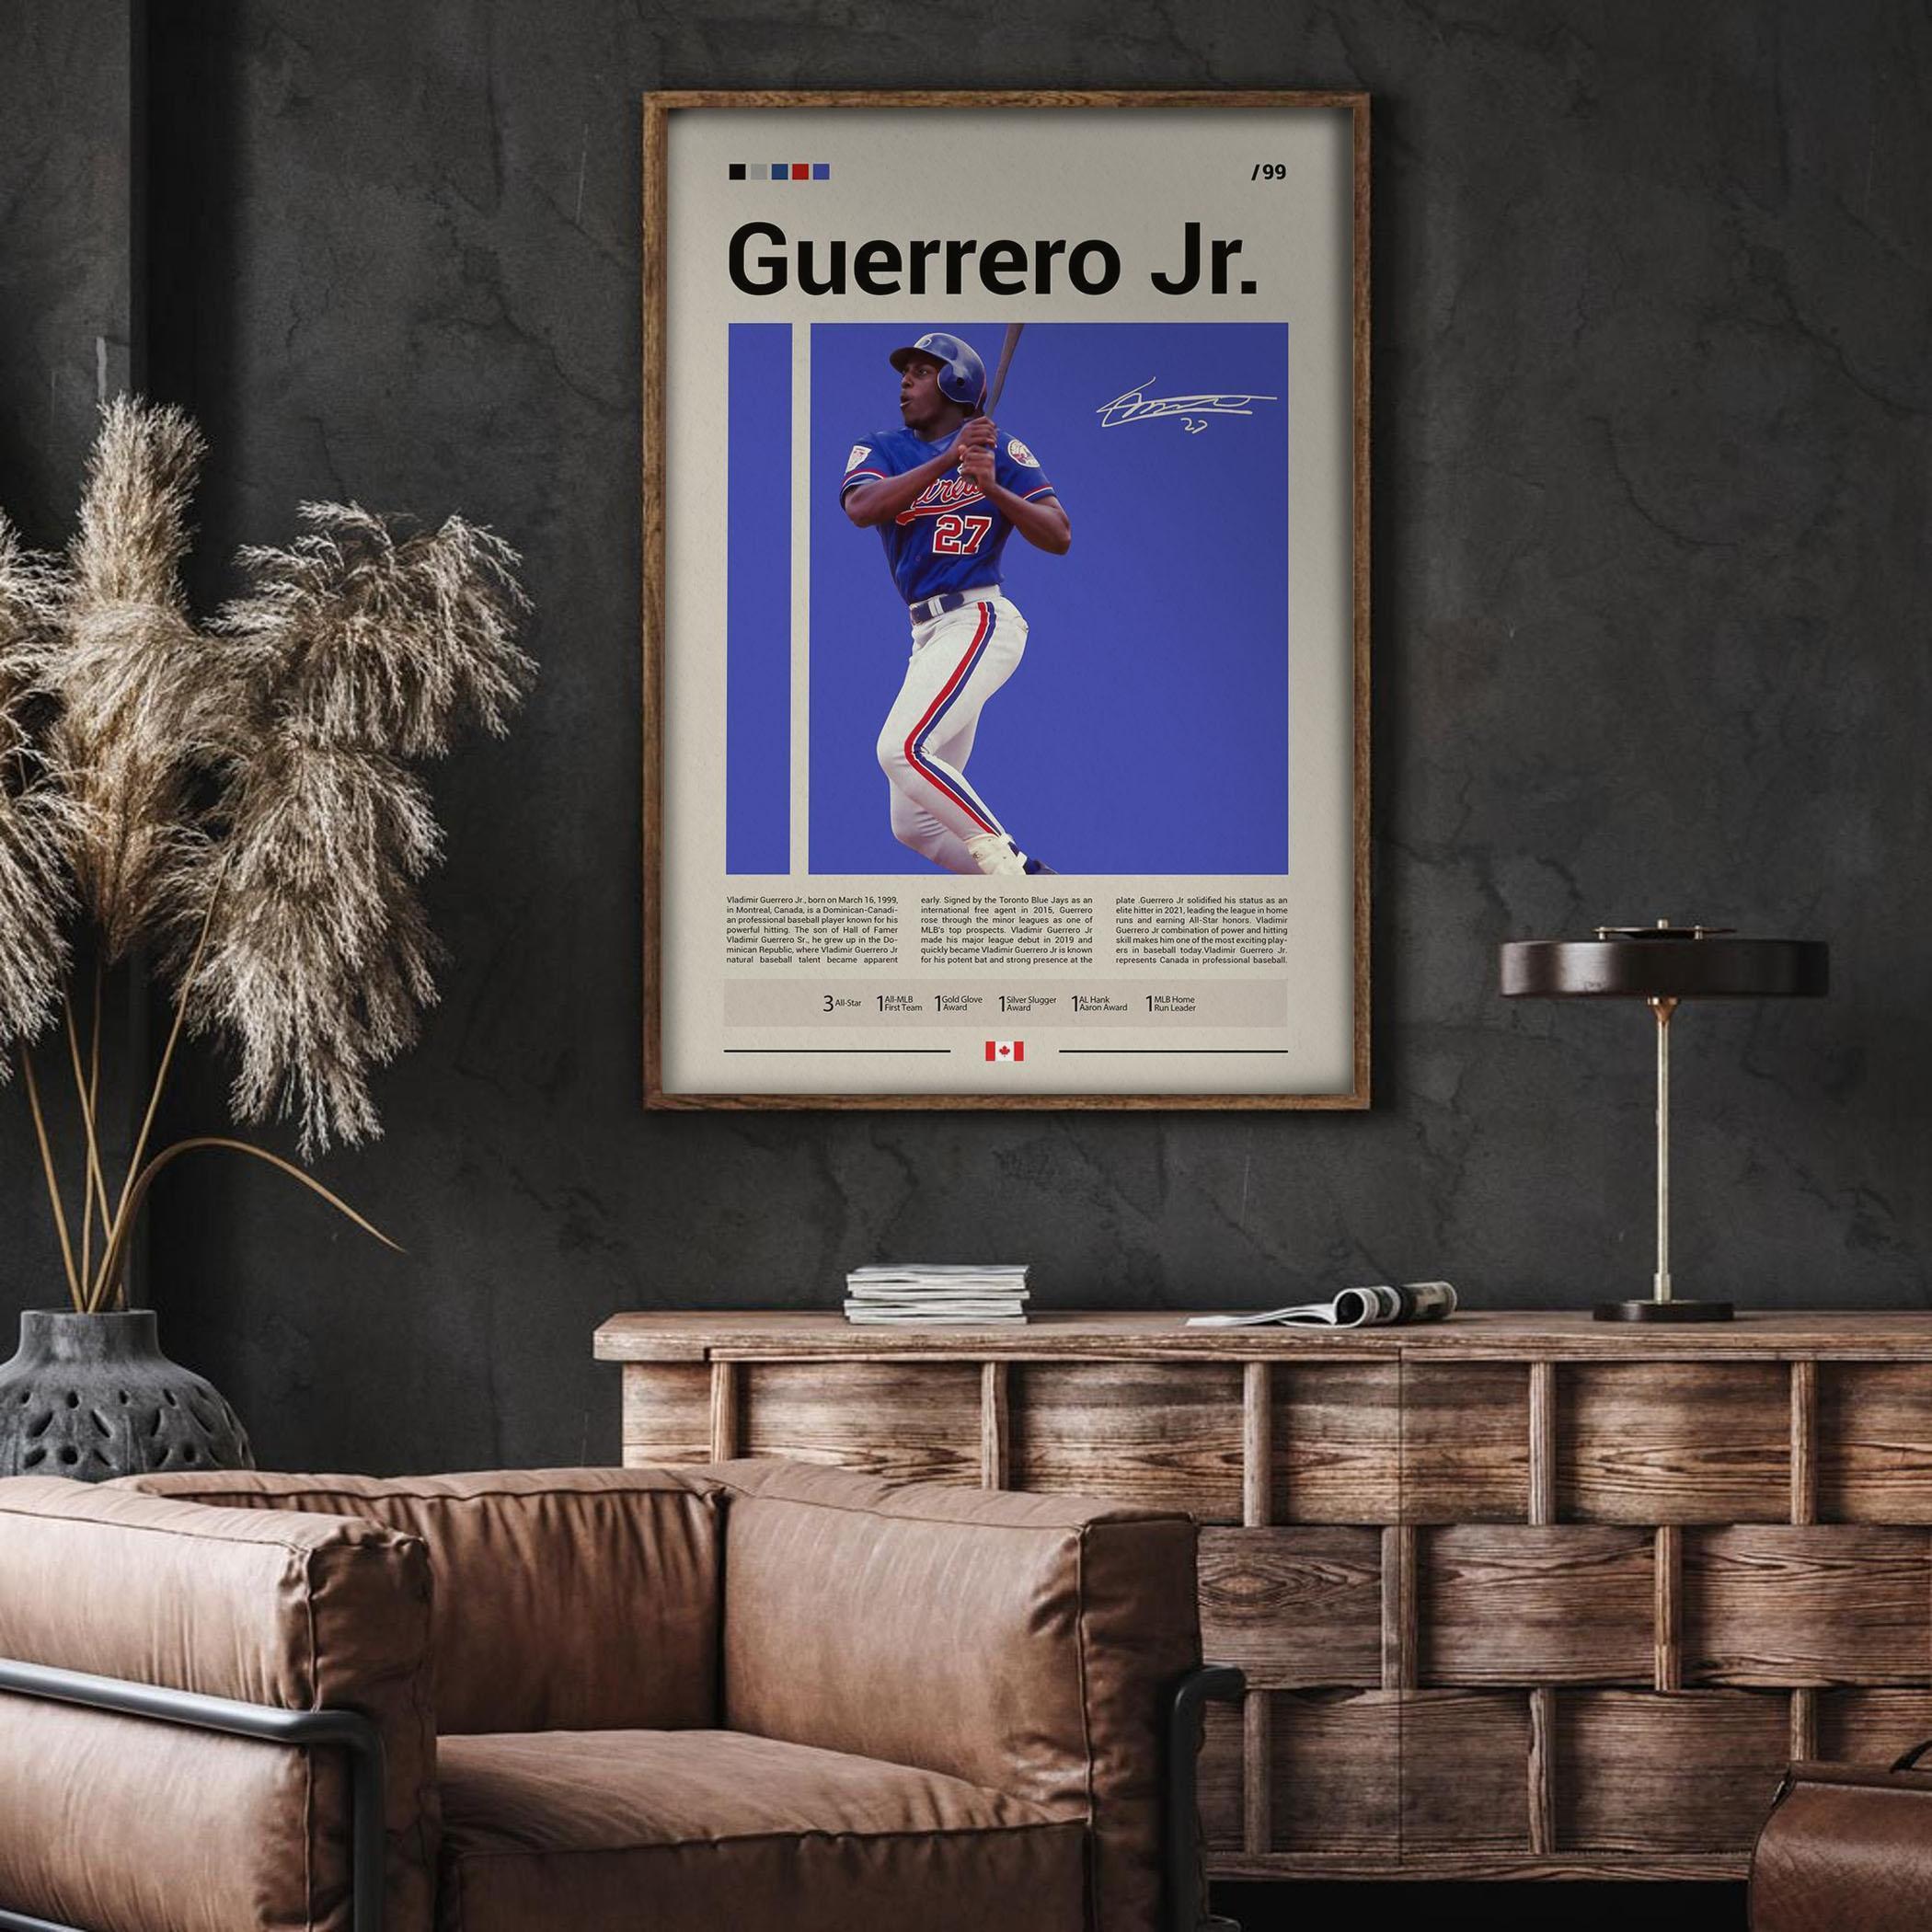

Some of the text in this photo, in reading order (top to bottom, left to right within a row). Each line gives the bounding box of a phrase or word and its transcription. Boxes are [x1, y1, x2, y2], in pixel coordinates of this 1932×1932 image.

[1251, 164, 1286, 181] /99
[729, 222, 1257, 295] Guerrero Jr.
[932, 514, 993, 555] 27
[865, 896, 876, 904] 16,
[878, 896, 899, 904] 1999,
[921, 896, 941, 905] early.
[944, 896, 971, 905] Signed
[1051, 896, 1069, 905] Jays
[1116, 896, 1135, 905] plate
[1187, 896, 1222, 904] solidified
[736, 905, 898, 914] Montreal, Canada, Dominican-Canadi-
[974, 905, 989, 914] free
[994, 907, 1016, 915] agent
[1033, 906, 1054, 914] 2015,
[1165, 906, 1186, 914] 2021,
[1187, 906, 1215, 916] leading
[1230, 906, 1256, 915] league
[1266, 906, 1288, 914] home
[738, 915, 786, 925] professional
[788, 915, 820, 924] baseball
[822, 915, 845, 926] player
[874, 915, 885, 924] for
[942, 915, 972, 926] through
[1018, 916, 1049, 926] leagues
[1156, 916, 1185, 926] earning
[726, 926, 760, 935] powerful
[764, 926, 790, 936] hitting.
[795, 926, 810, 934] The
[843, 926, 858, 934] Hall
[949, 926, 962, 935] top
[966, 926, 1006, 935] prospects.
[1010, 926, 1042, 934] Vladimir
[1221, 927, 1245, 936] power
[1263, 926, 1288, 936] hitting
[761, 936, 795, 944] Guerrero
[868, 936, 881, 944] the
[921, 936, 1093, 945] made his major league debut 2019 and
[1116, 936, 1132, 944] skill
[1159, 936, 1175, 944] him
[1191, 936, 1200, 944] of
[1236, 937, 1267, 946] exciting
[1268, 936, 1287, 946] play-
[759, 946, 794, 955] Republic,
[920, 946, 949, 955] quickly
[949, 946, 980, 954] became
[1015, 946, 1049, 954] Guerrero
[1144, 946, 1176, 954] baseball
[1239, 946, 1273, 954] Guerrero
[863, 957, 898, 965] apparent
[921, 955, 932, 963] for
[948, 957, 972, 965] potent
[1006, 957, 1031, 965] strong
[1116, 957, 1157, 965] represents
[1159, 956, 1189, 964] Canada
[1202, 956, 1250, 965] professional
[1253, 956, 1288, 964] baseball.
[822, 995, 861, 1012] 3 All-Star
[877, 995, 883, 1012] 1
[935, 995, 940, 1012] 1
[960, 995, 983, 1004] Glove
[998, 995, 1057, 1012] 1 Silver Slugger
[1071, 995, 1110, 1012] 1 AL Hank
[1103, 1003, 1128, 1011] Award
[1145, 995, 1195, 1012] 1 MLB Home
[1154, 1004, 1196, 1012] Run Leader
